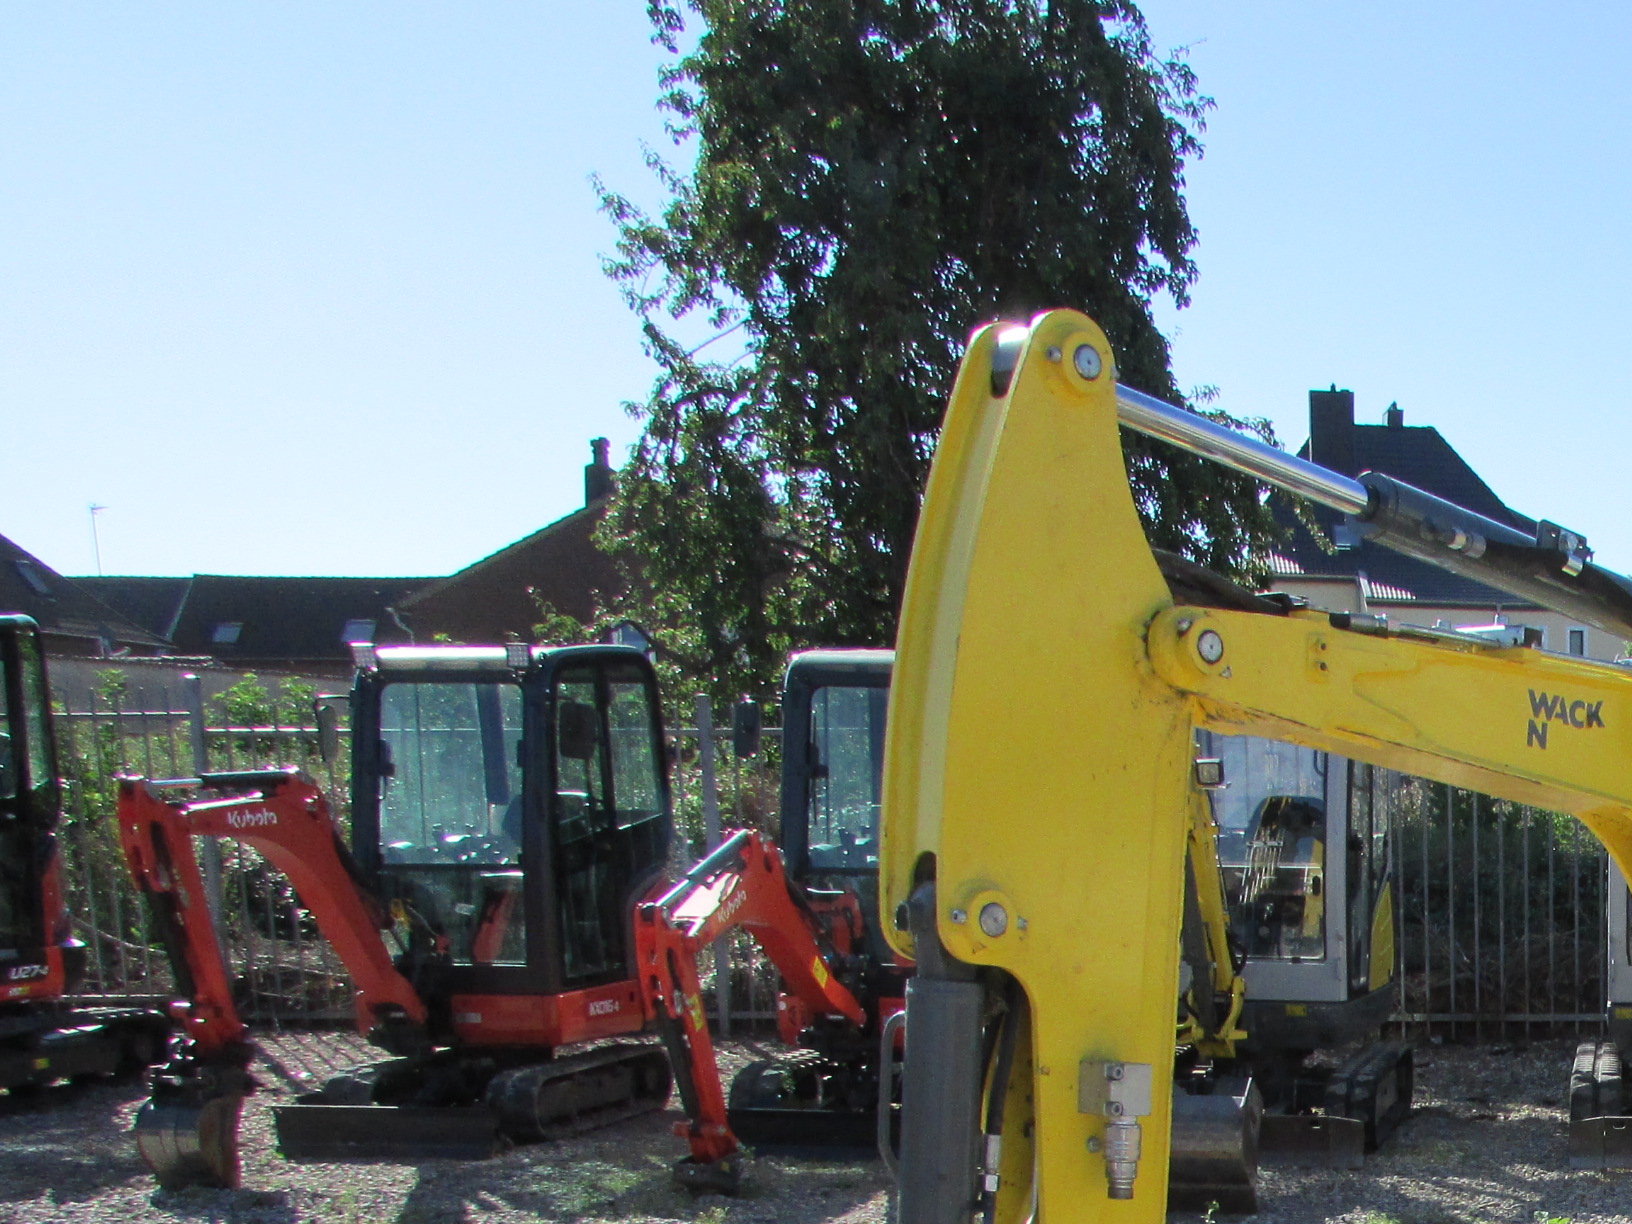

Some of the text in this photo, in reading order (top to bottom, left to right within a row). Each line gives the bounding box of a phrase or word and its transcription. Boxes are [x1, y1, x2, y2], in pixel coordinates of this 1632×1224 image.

[1528, 688, 1605, 729] WACK
[1527, 718, 1548, 750] N
[227, 808, 277, 828] Kubota
[717, 890, 747, 922] Kubota
